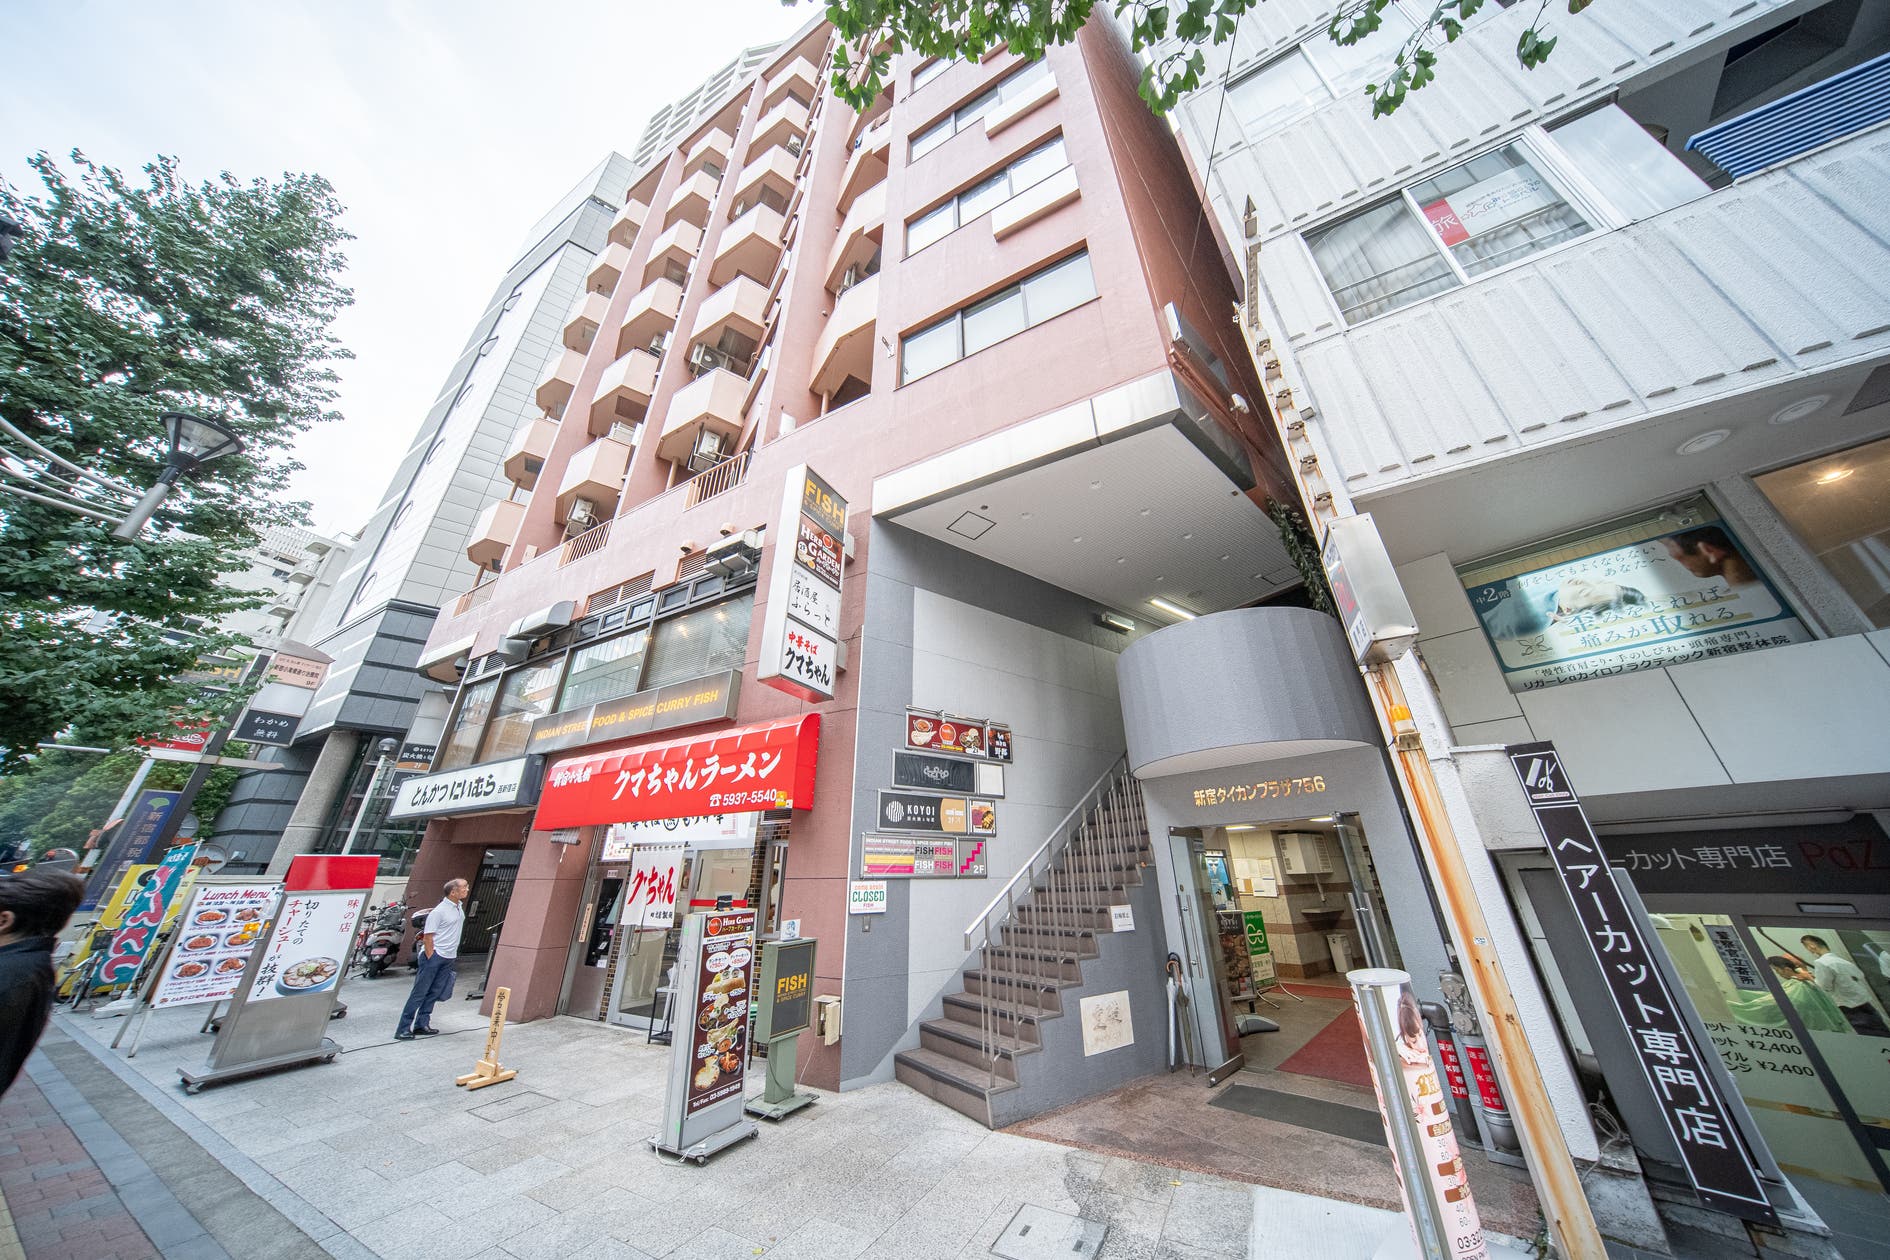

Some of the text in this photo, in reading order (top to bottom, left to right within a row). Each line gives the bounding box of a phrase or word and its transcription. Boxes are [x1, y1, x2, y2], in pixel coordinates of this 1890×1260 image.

[804, 478, 845, 524] FISH
[808, 541, 841, 571] GARDEN
[1517, 546, 1657, 590] 何をしてもよくならない
[1604, 557, 1666, 577] あなたへ
[793, 579, 818, 605] 居酒屋
[1566, 586, 1727, 633] 歪みをとれば
[1580, 606, 1735, 648] 痛みが取れる
[788, 631, 818, 655] 中華そば
[785, 647, 831, 686] クマちゃん
[254, 715, 289, 728] わかめ
[535, 727, 562, 742] INDIAN
[592, 716, 617, 729] FOOD
[619, 711, 626, 723] &
[628, 704, 656, 720] SPICE
[656, 696, 692, 714] CURRY
[693, 689, 719, 706] FISH
[612, 747, 782, 800] クマちゃんラーメン
[722, 788, 777, 807] 5937-5540
[1193, 775, 1326, 807] 新宿タイカンプラザ756
[907, 804, 935, 816] KOYOI
[915, 846, 934, 855] FISH
[935, 847, 952, 855] FISH
[914, 860, 952, 869] FISH FISH
[973, 864, 985, 874] 2F
[202, 889, 271, 900] Lunch Menu
[852, 890, 885, 902] CLOSED
[292, 899, 320, 945] 切りたての
[340, 899, 359, 933] 味の店
[1716, 931, 1755, 985] 警察官立寄所
[777, 973, 808, 994] FISH
[1557, 837, 1728, 1150] ヘアーカット専門店
[1737, 1024, 1794, 1040] ¥1,200
[1745, 1040, 1802, 1055] ¥2,400
[1756, 1059, 1815, 1077] ¥2,400
